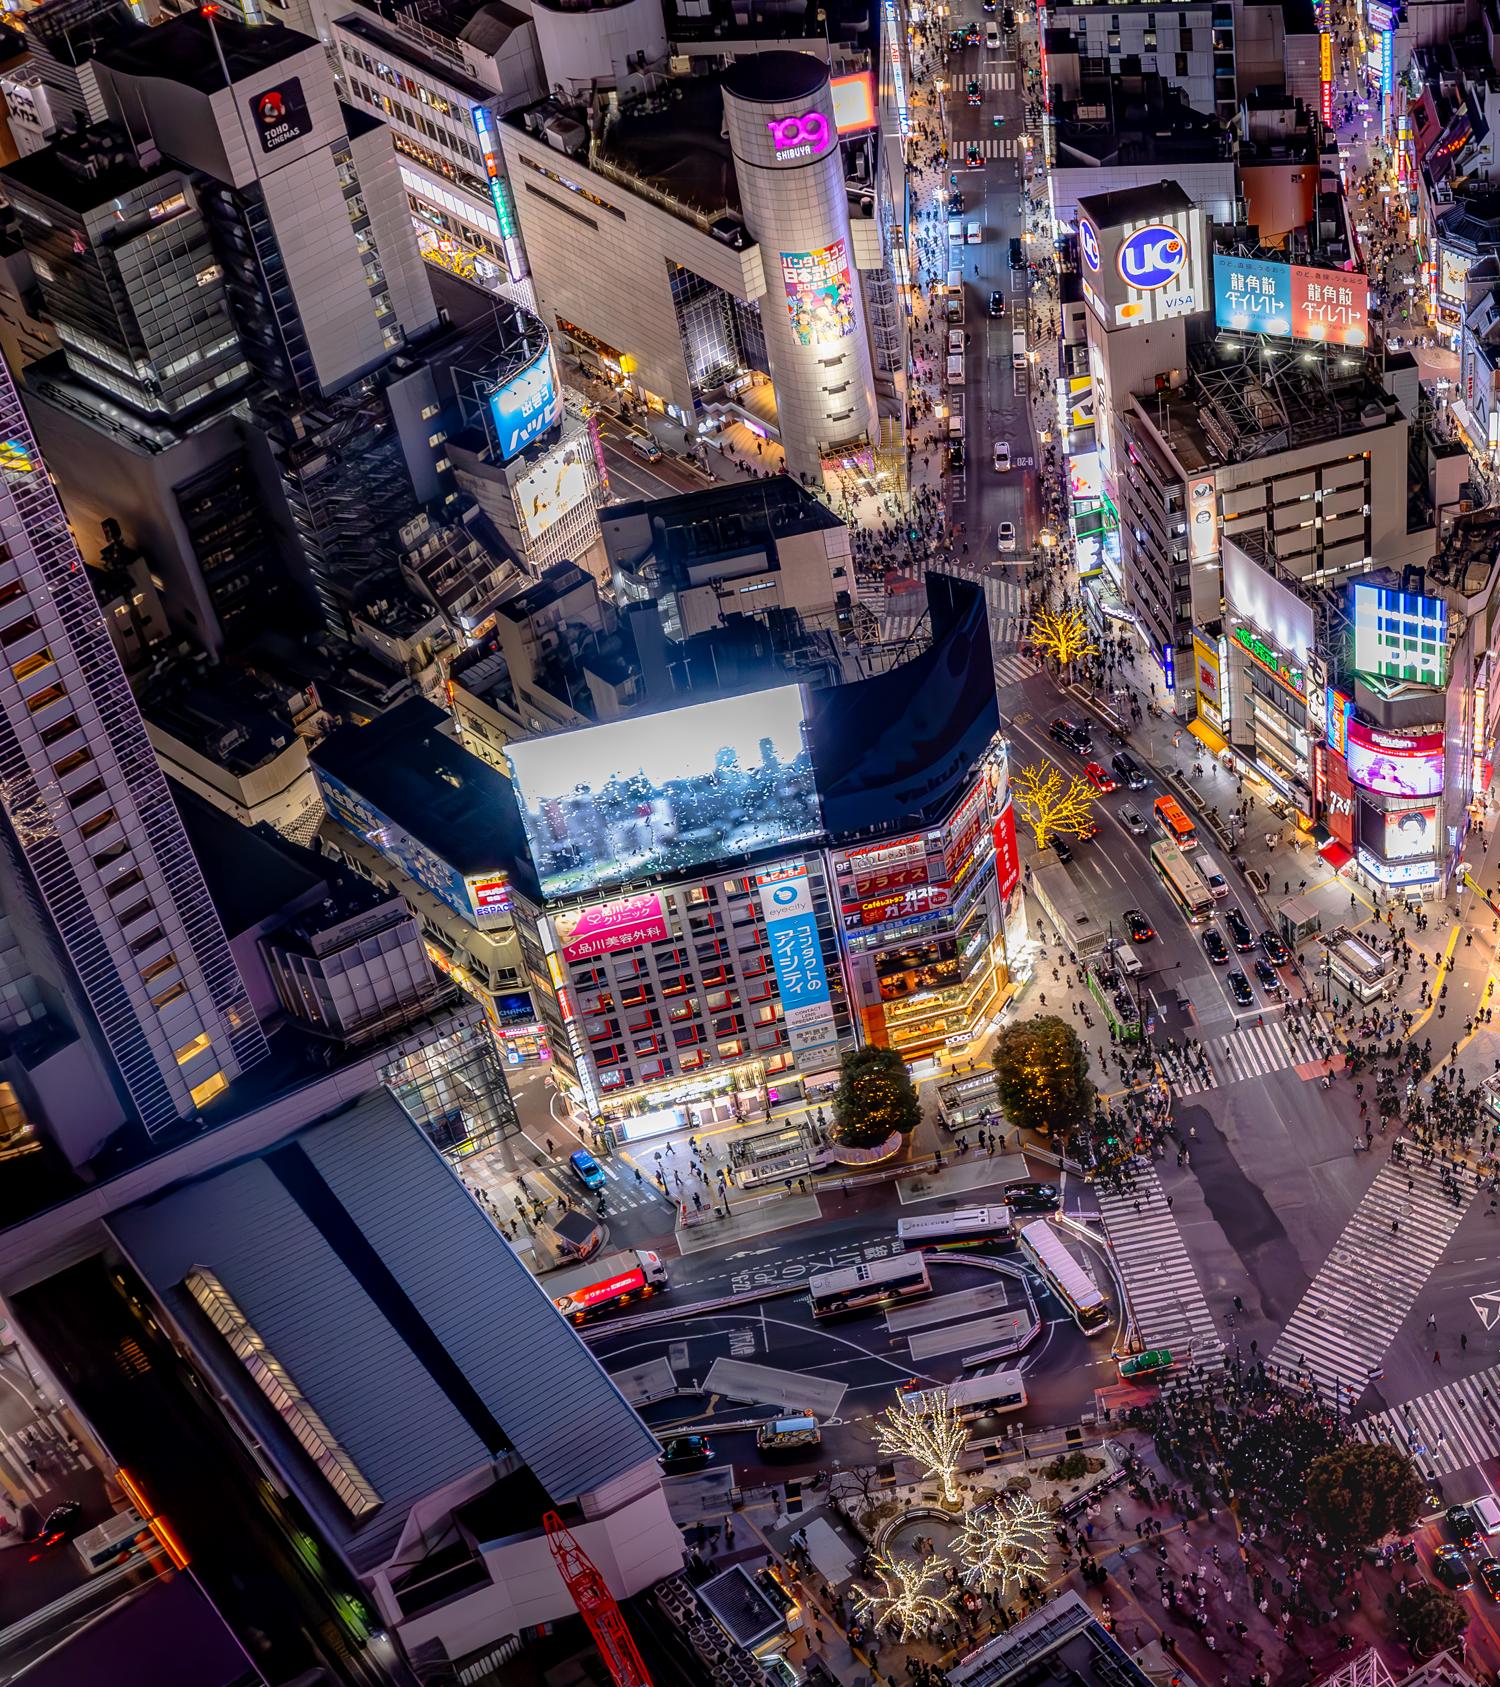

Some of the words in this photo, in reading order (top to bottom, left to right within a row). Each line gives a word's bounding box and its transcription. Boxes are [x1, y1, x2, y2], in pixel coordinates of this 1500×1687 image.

[264, 122, 289, 140] TOHO
[267, 127, 301, 149] CINEMAS
[767, 112, 831, 154] 109
[775, 145, 811, 161] SHIBUYA
[783, 254, 848, 283] 日本武道館
[1231, 273, 1276, 296] 龍角散
[1166, 295, 1193, 307] VISA
[1225, 291, 1285, 314] ダイレクト
[1308, 283, 1353, 306] 龍角散
[1301, 302, 1361, 324] ダイレクト
[836, 862, 849, 871] 9F
[905, 886, 939, 902] ガスト
[601, 898, 654, 917] 品川スキン
[603, 908, 651, 925] クリニック
[769, 902, 806, 916] eyecity
[885, 900, 926, 918] ガスト
[844, 914, 860, 925] 7F
[578, 926, 661, 955] 品川美容外科
[774, 929, 803, 994] アイシティ
[797, 925, 822, 991] コンタクトの
[794, 1005, 821, 1016] CONTACT
